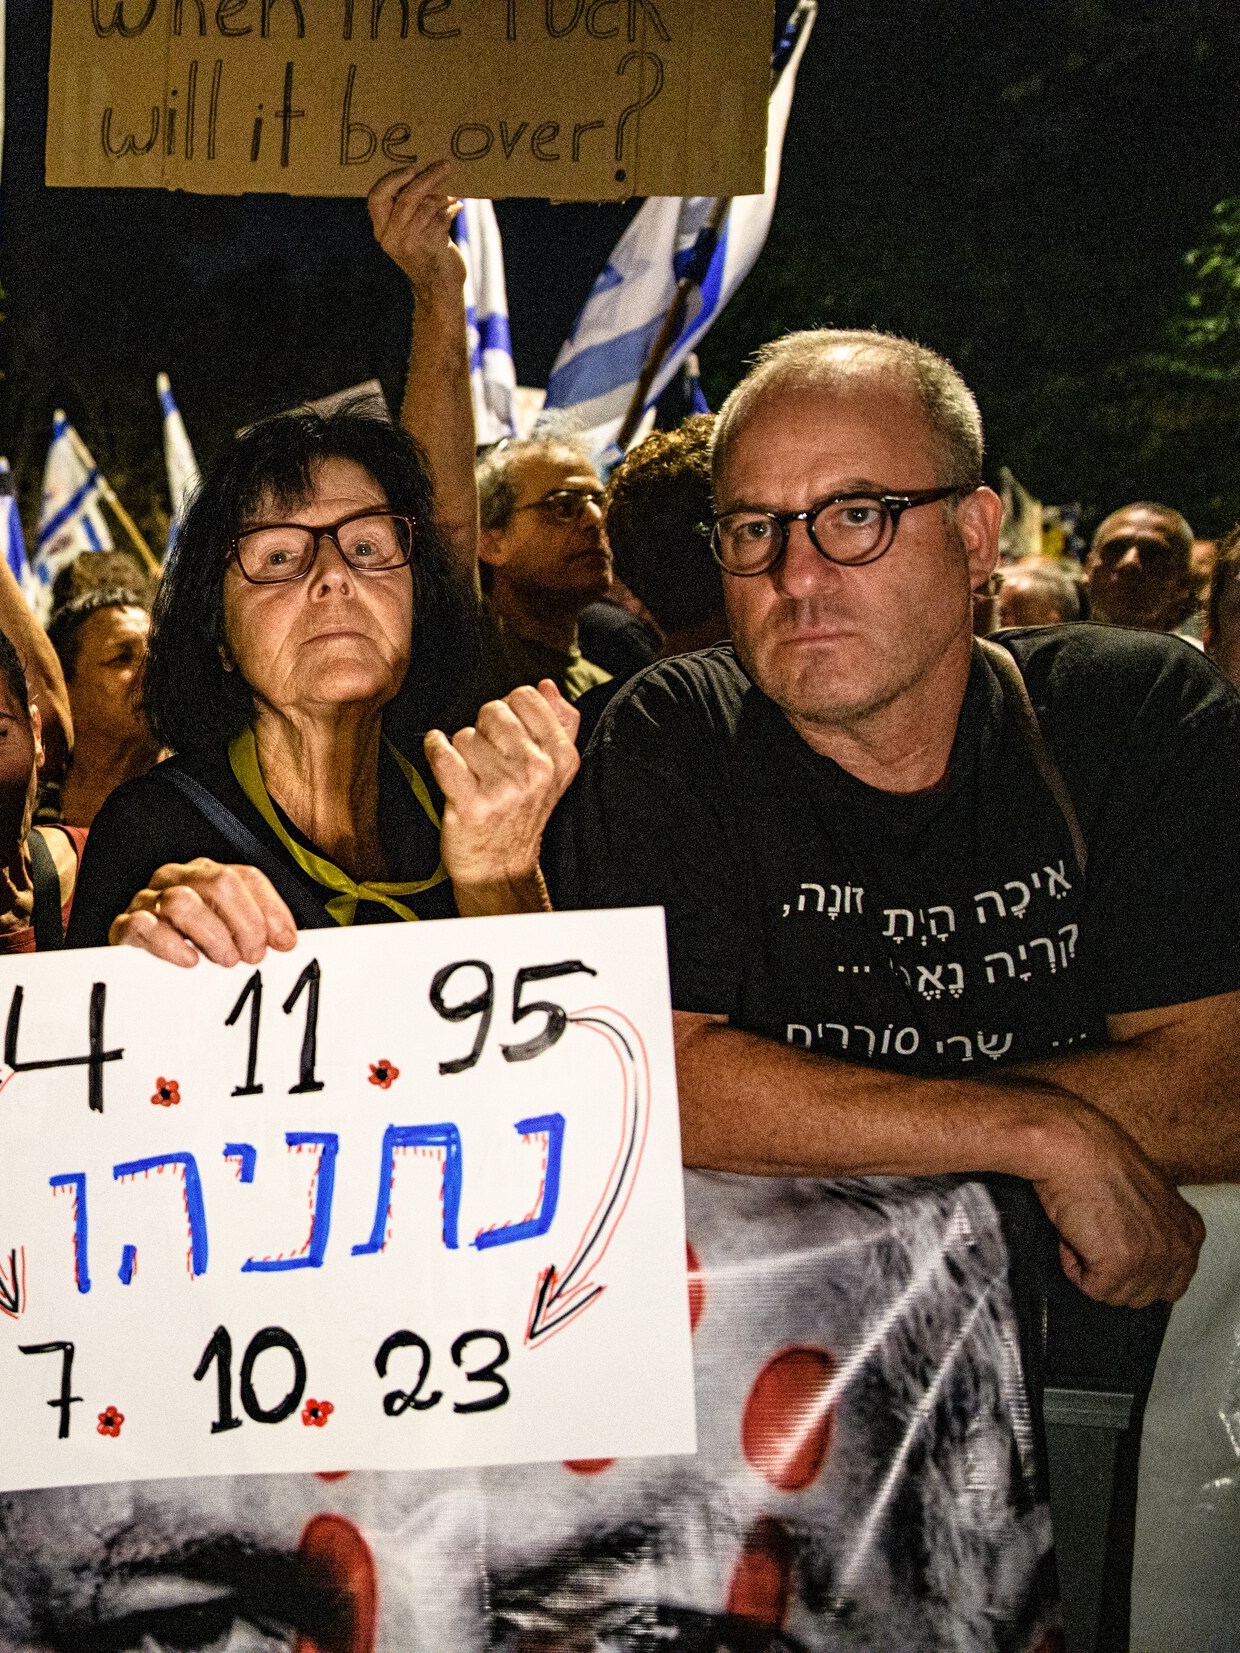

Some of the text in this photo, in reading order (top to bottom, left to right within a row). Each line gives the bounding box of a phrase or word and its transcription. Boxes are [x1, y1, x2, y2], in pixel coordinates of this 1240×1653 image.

[101, 50, 664, 183] will it be over?
[49, 1112, 567, 1294] נתניהו
